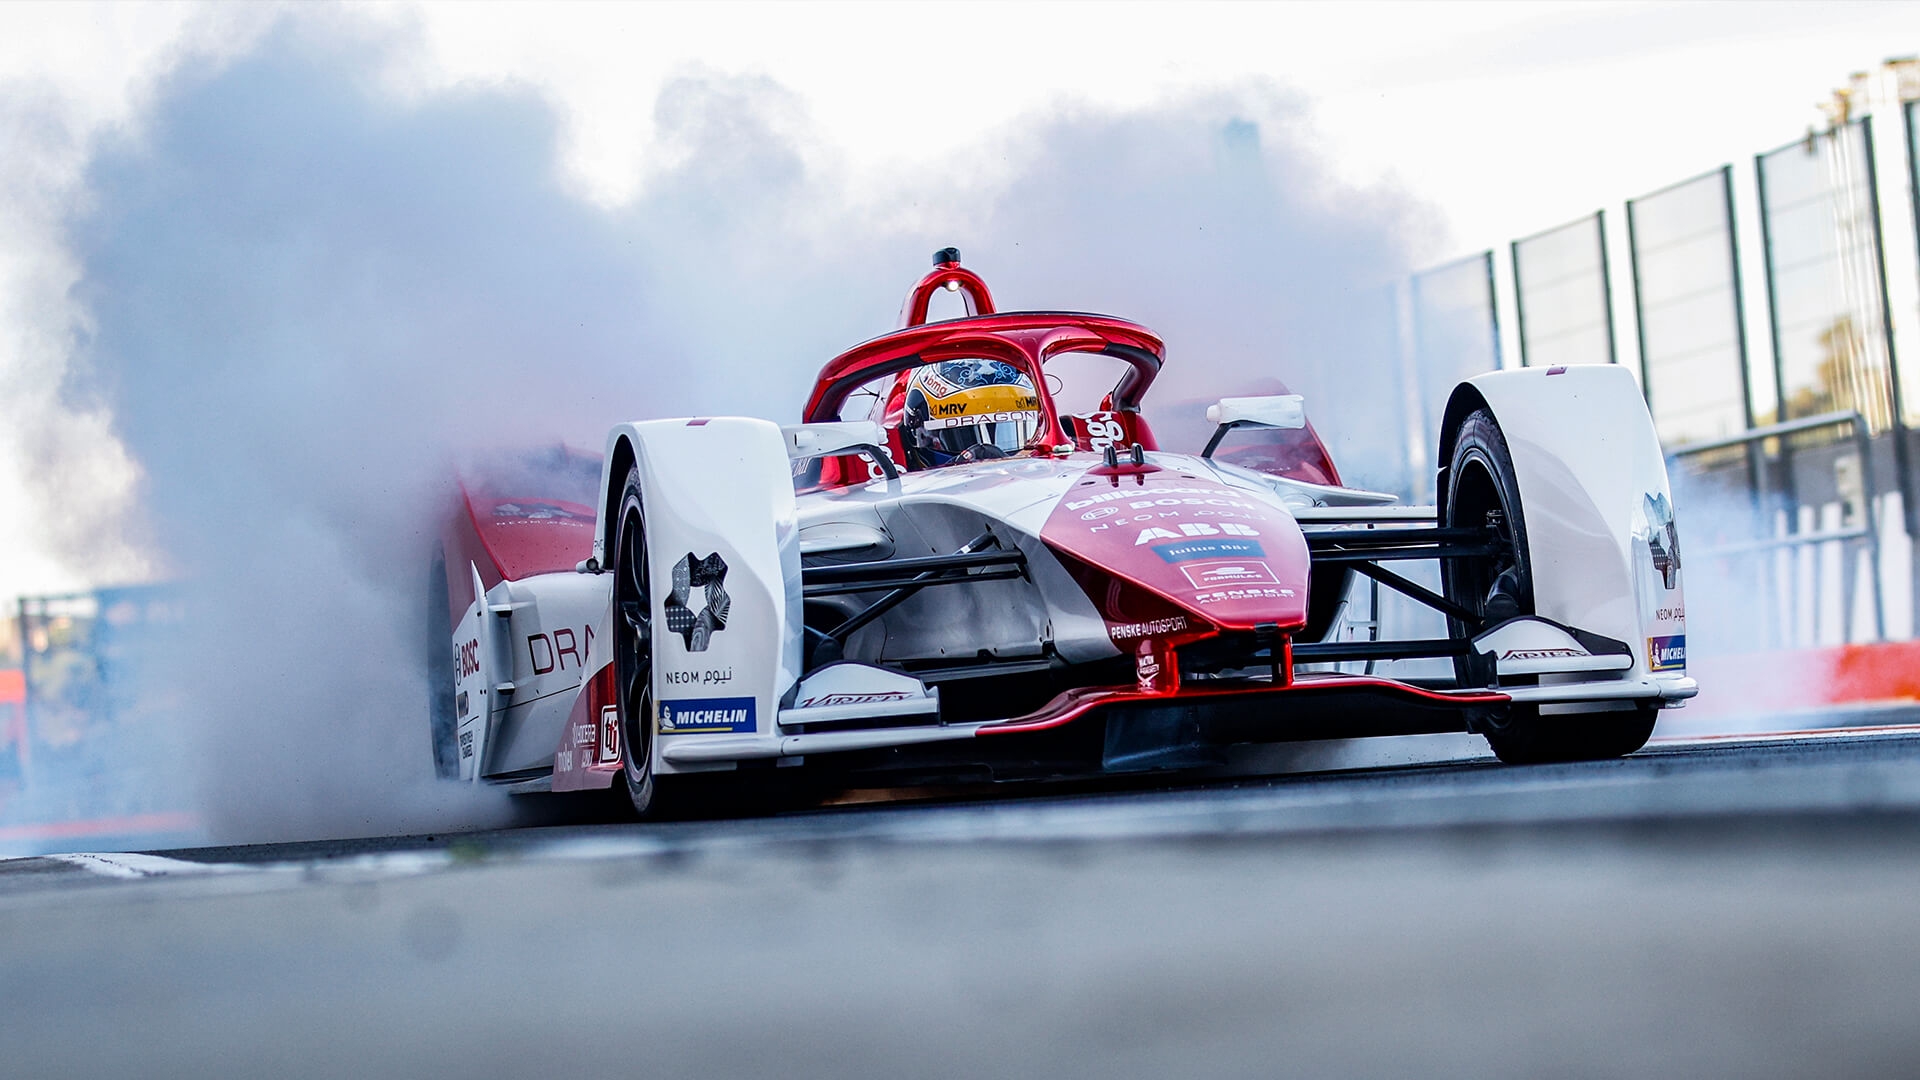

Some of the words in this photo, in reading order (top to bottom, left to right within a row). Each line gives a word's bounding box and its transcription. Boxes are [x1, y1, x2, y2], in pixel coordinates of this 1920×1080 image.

[939, 402, 967, 416] MRV
[945, 411, 1035, 427] DRAGON
[1064, 488, 1242, 511] billboard
[1128, 498, 1256, 510] BOSCH
[1090, 510, 1179, 533] NEOM
[1135, 522, 1260, 546] ABB
[1168, 546, 1216, 556] Julius
[1195, 588, 1295, 601] PENSKE
[1199, 592, 1296, 605] AUTOSPORT
[1655, 608, 1673, 621] NEOM
[1111, 623, 1142, 640] PENSKE
[1141, 616, 1188, 637] AUTOSPORT
[461, 638, 480, 679] BOSC
[527, 624, 595, 676] DRA
[666, 671, 699, 684] NEOM
[703, 666, 732, 685] نيوم
[801, 691, 914, 709] VARIETY
[676, 709, 748, 724] MICHELIN
